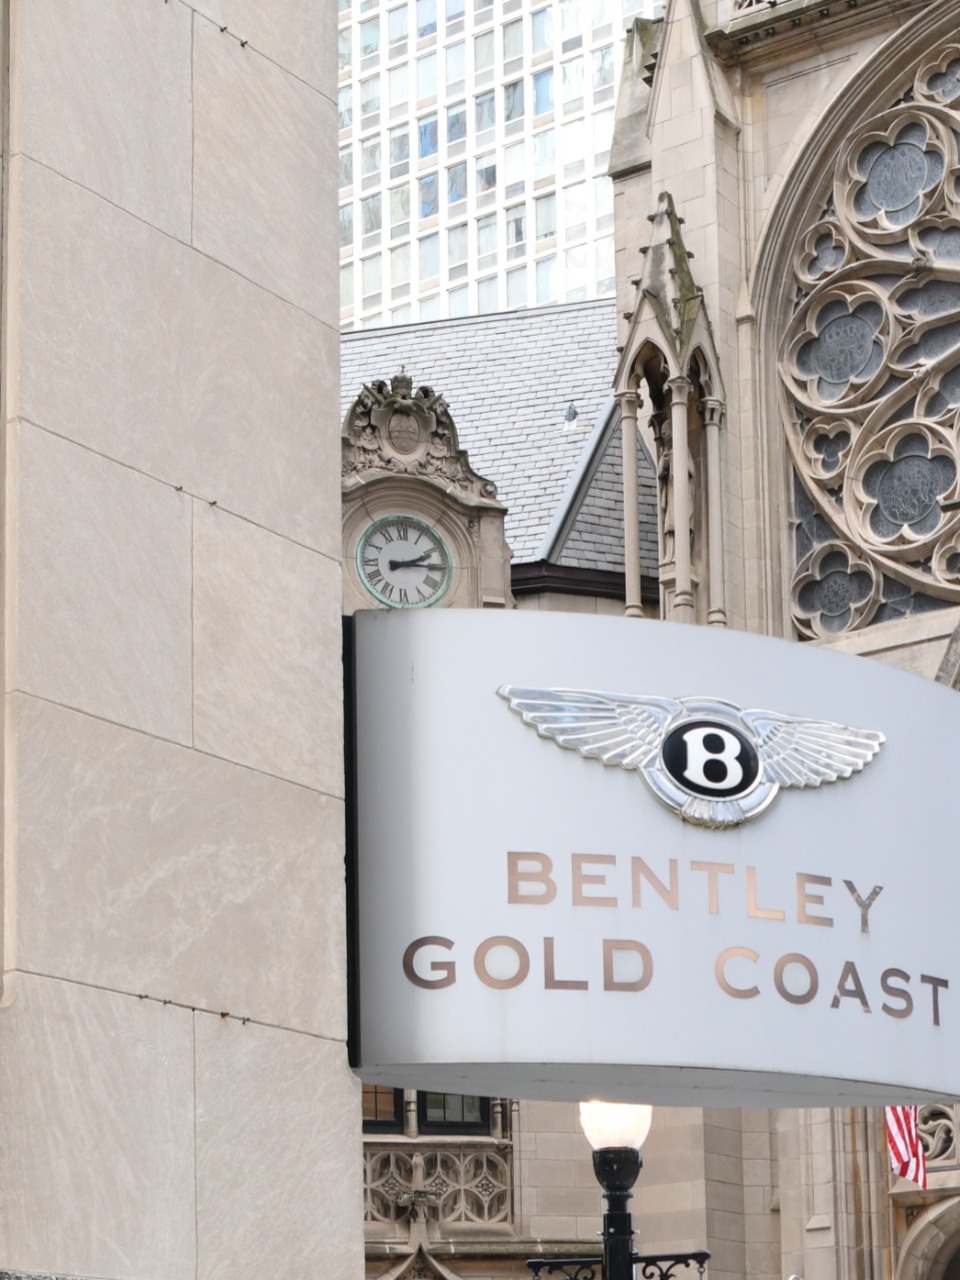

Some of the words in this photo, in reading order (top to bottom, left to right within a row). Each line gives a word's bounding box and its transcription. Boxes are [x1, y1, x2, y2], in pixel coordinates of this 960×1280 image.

[683, 727, 744, 791] B
[506, 850, 885, 934] BENTLEY
[402, 935, 654, 993] GOLD
[713, 946, 950, 1027] COAST
